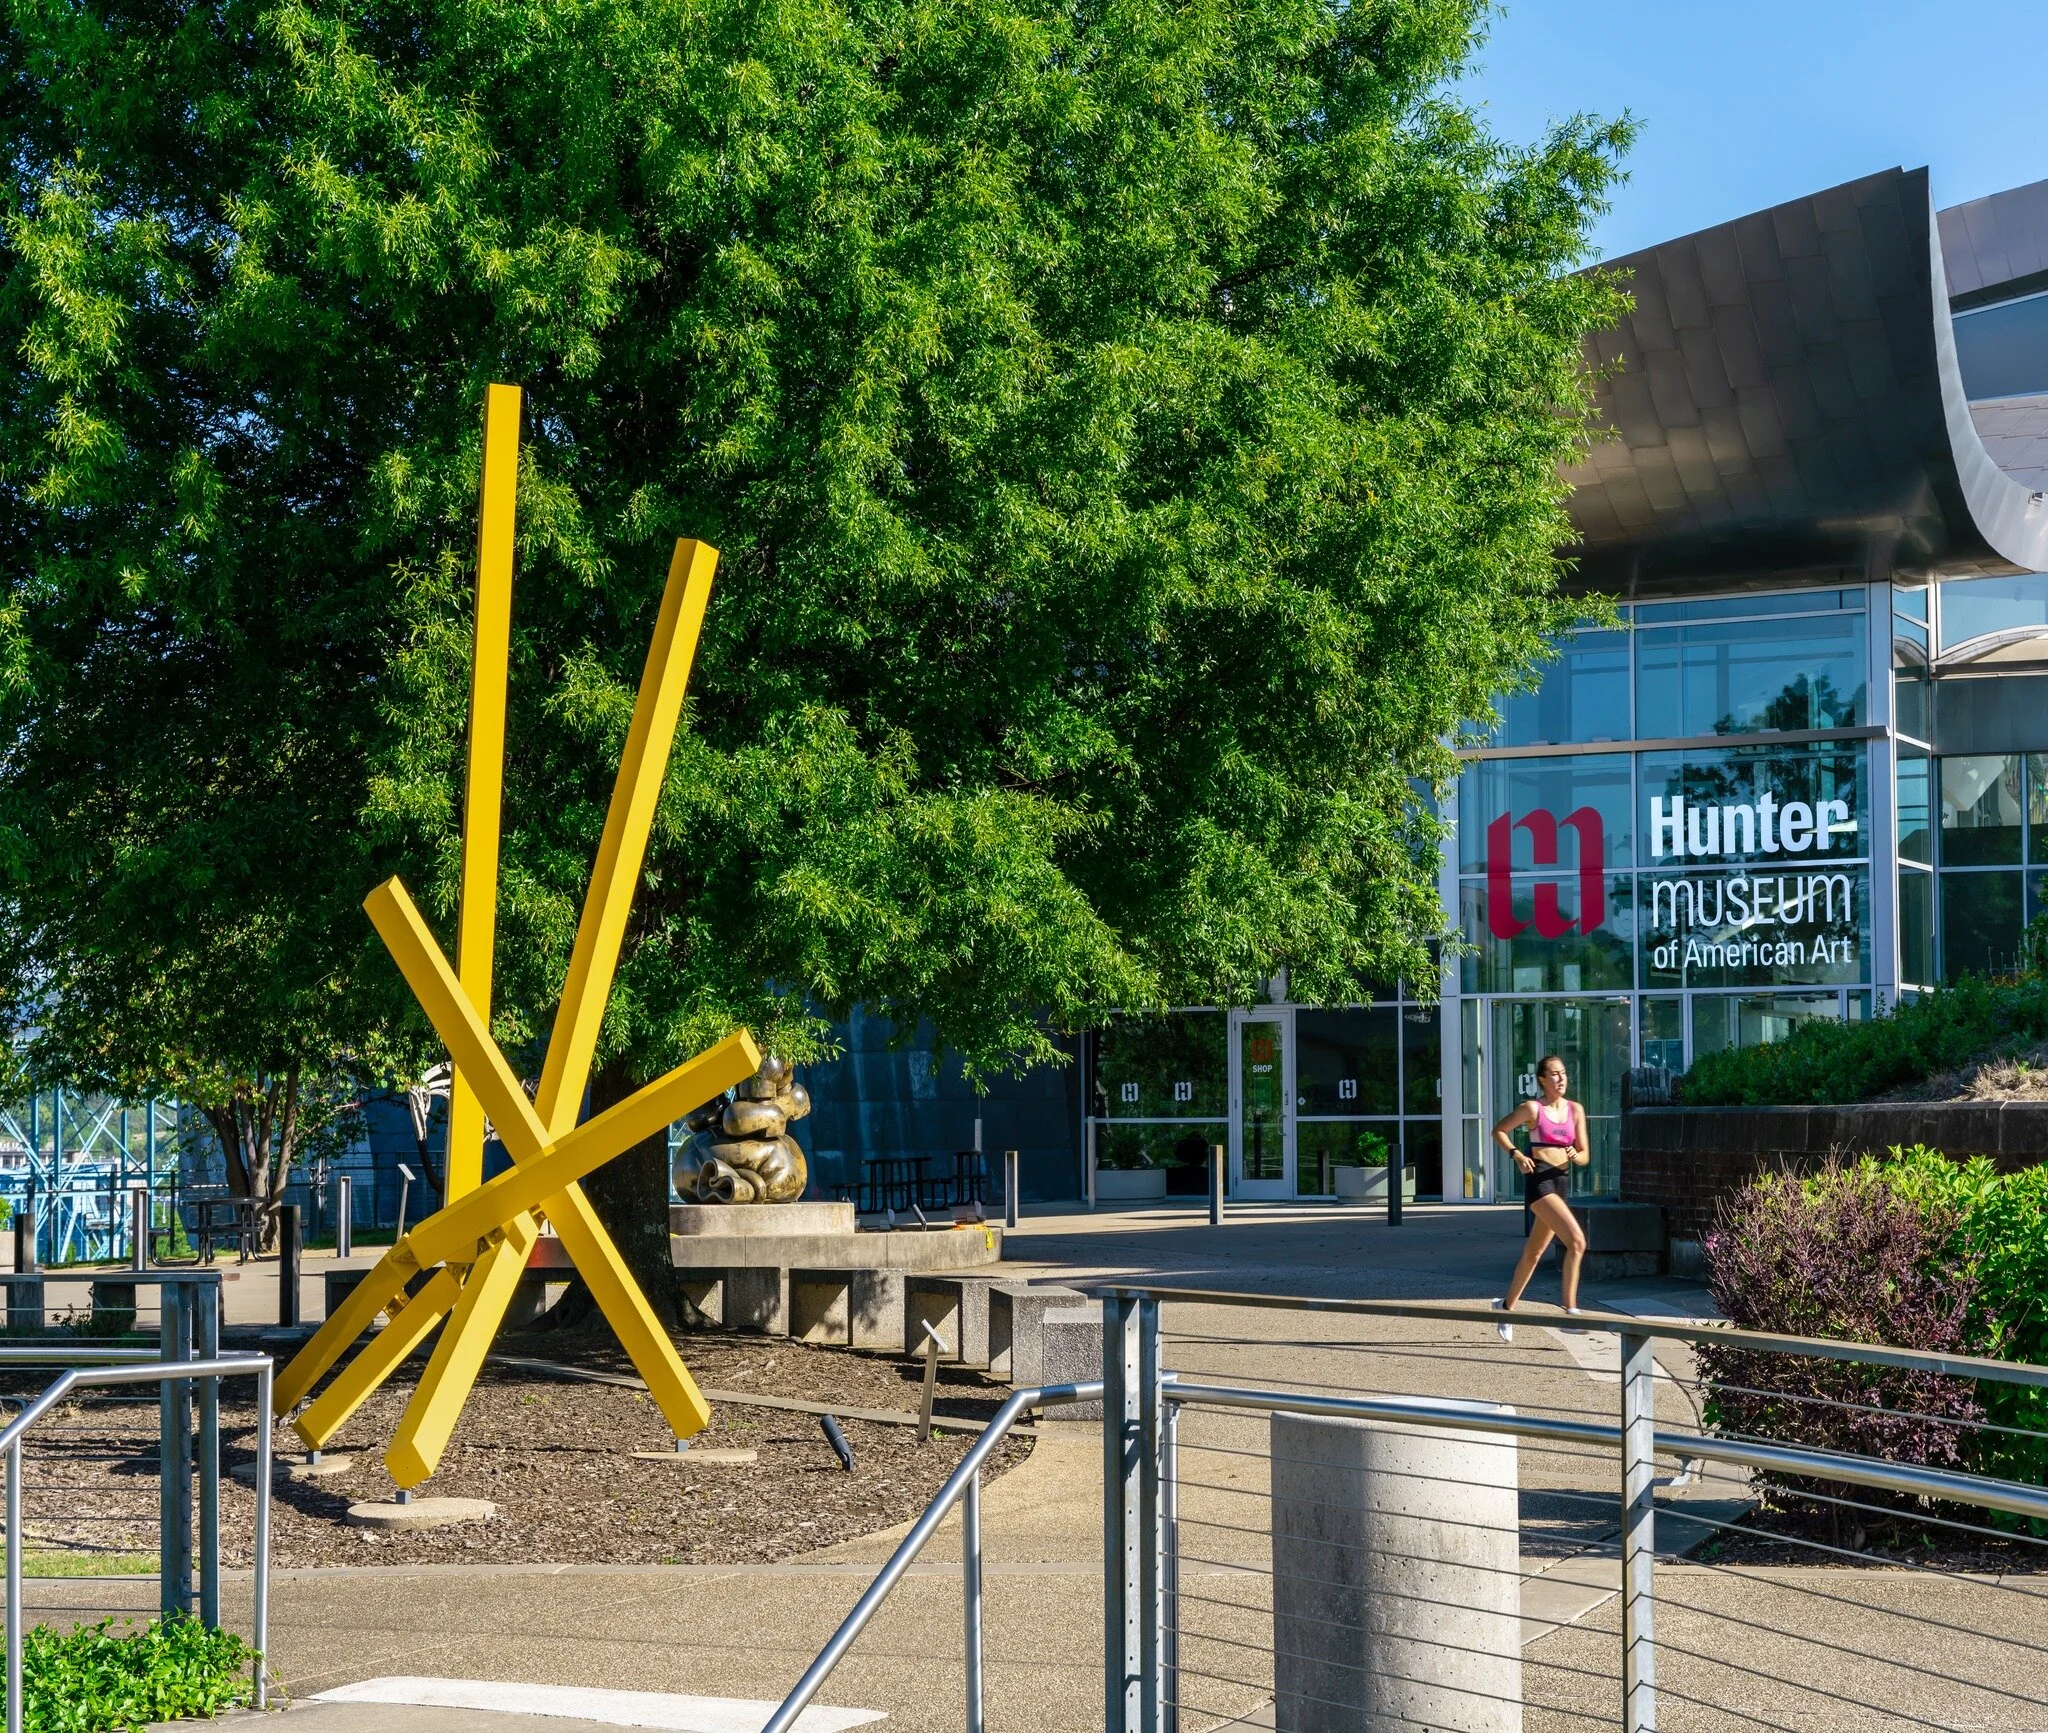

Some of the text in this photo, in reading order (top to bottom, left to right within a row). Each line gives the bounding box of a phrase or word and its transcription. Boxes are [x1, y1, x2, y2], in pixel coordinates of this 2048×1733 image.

[1651, 791, 1849, 857] Hunter
[1653, 934, 1852, 969] of American Art
[1252, 1064, 1273, 1073] SHOP
